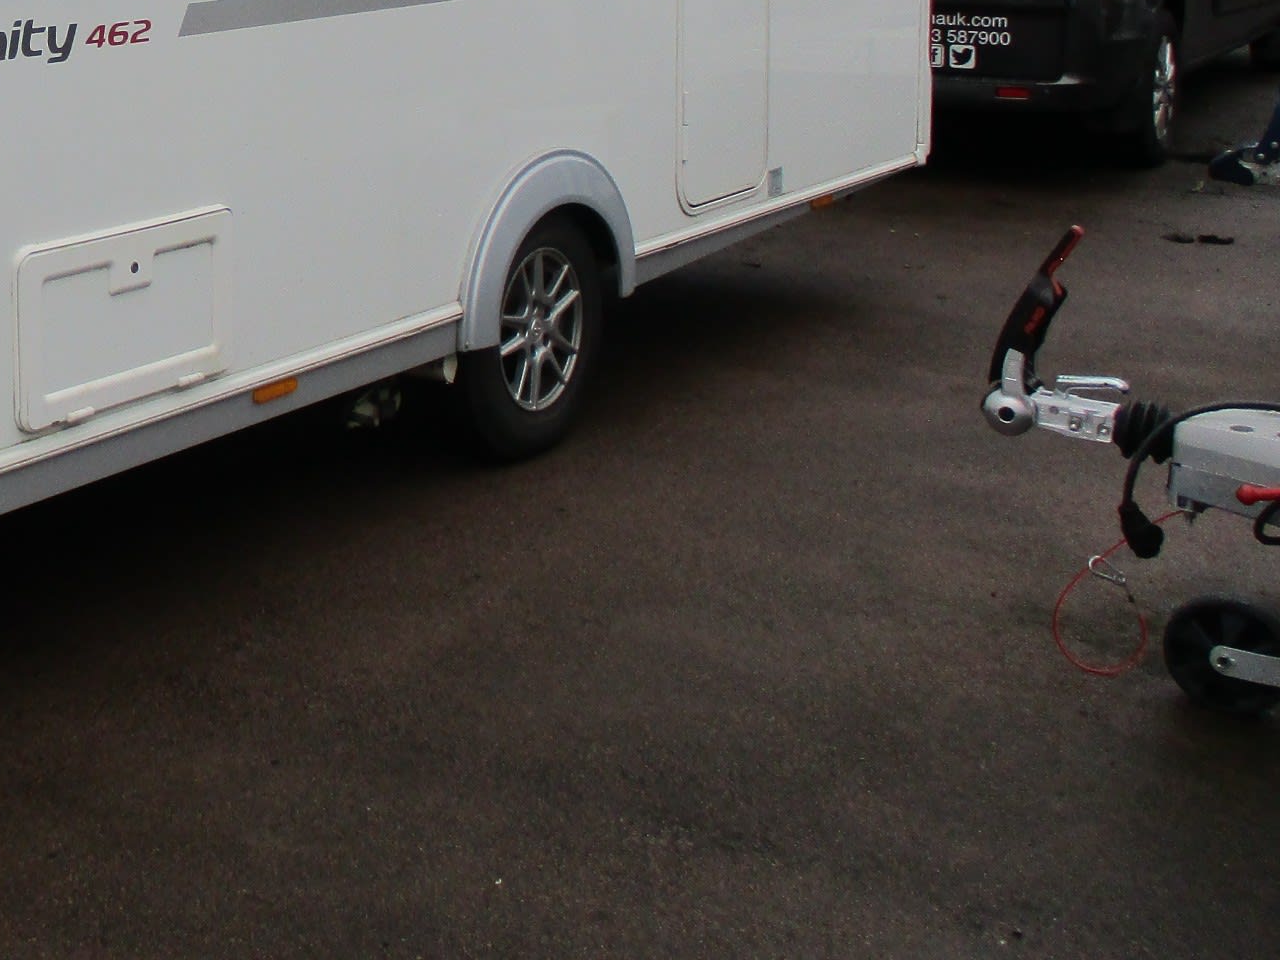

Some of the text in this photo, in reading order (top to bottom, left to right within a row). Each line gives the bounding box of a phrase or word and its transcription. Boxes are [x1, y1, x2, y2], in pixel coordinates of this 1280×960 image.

[932, 12, 1008, 28] auk.com
[86, 19, 152, 48] 462
[946, 30, 1011, 46] 587900
